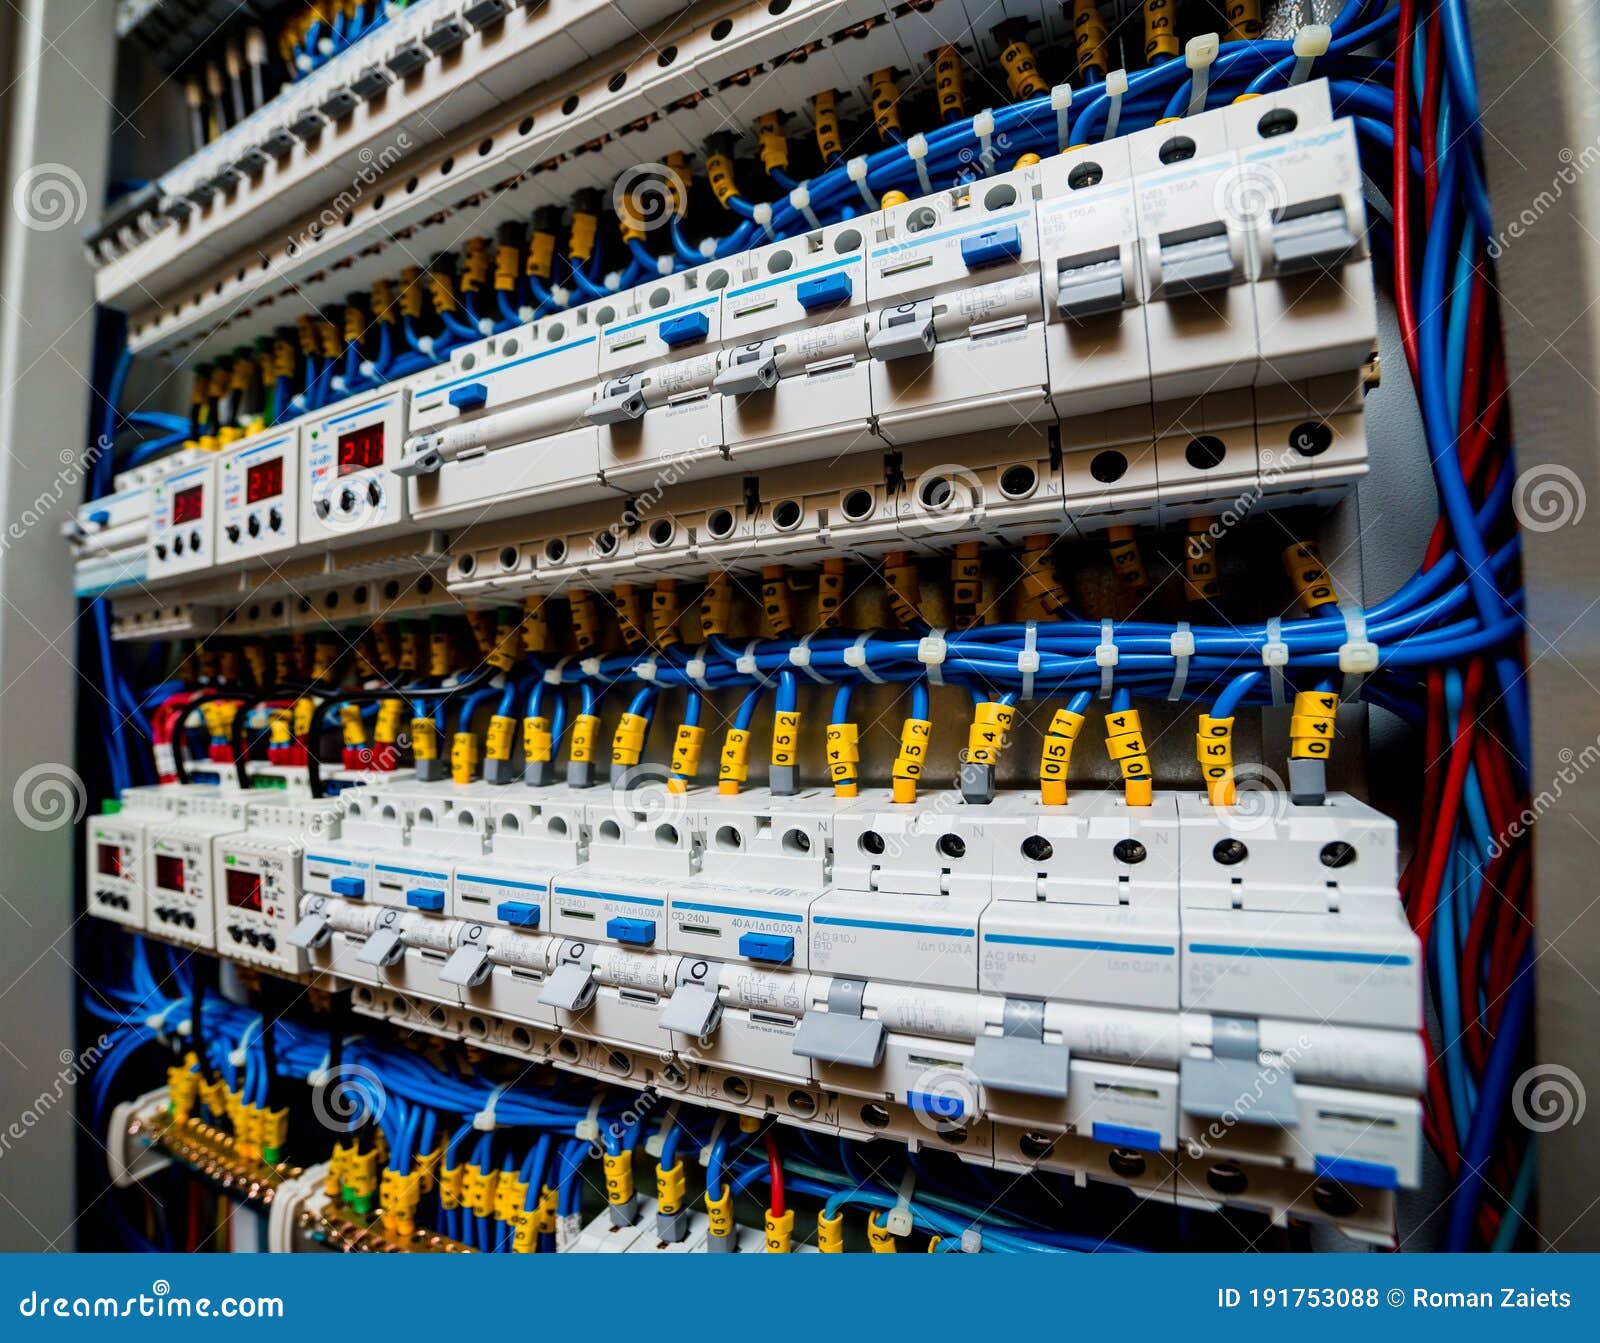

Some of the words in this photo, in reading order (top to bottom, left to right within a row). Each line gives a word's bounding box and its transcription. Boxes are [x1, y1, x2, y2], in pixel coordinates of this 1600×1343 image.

[1046, 483, 1058, 496] N
[775, 716, 797, 763] 052
[974, 712, 1012, 760] 043
[1045, 717, 1073, 775] 051
[1112, 716, 1145, 774] 044
[1308, 696, 1335, 754] 044
[721, 734, 744, 774] 045
[827, 730, 848, 776] 043
[905, 724, 930, 775] 052
[1207, 726, 1229, 779] 050
[818, 821, 828, 833] N
[973, 825, 984, 838] N
[672, 911, 685, 922] CD
[687, 913, 710, 925] 240J
[731, 917, 743, 928] 40
[824, 1112, 834, 1123] N
